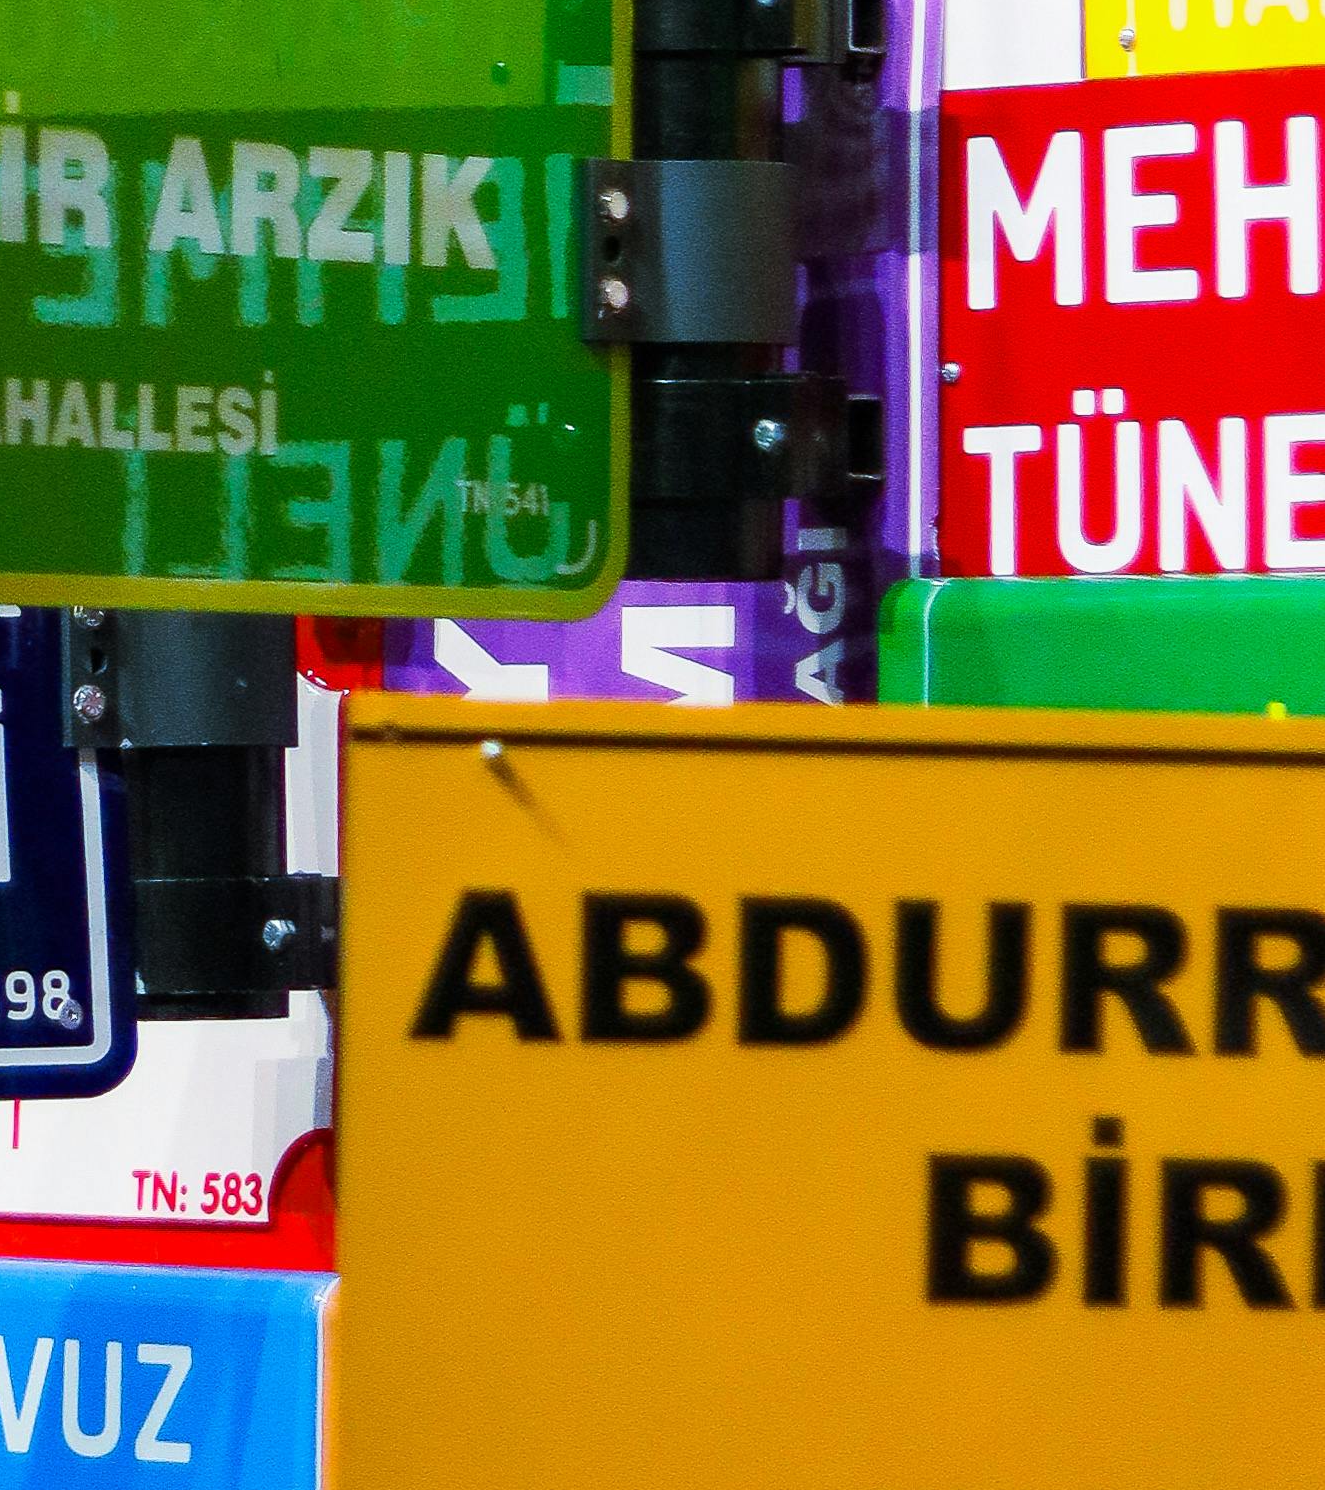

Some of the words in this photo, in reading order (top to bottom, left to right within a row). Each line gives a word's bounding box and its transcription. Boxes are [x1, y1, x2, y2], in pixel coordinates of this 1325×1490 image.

[148, 136, 497, 271] ARZIK
[132, 1170, 188, 1213] TN:
[201, 1171, 263, 1217] 583
[925, 1112, 1325, 1312] BİR
